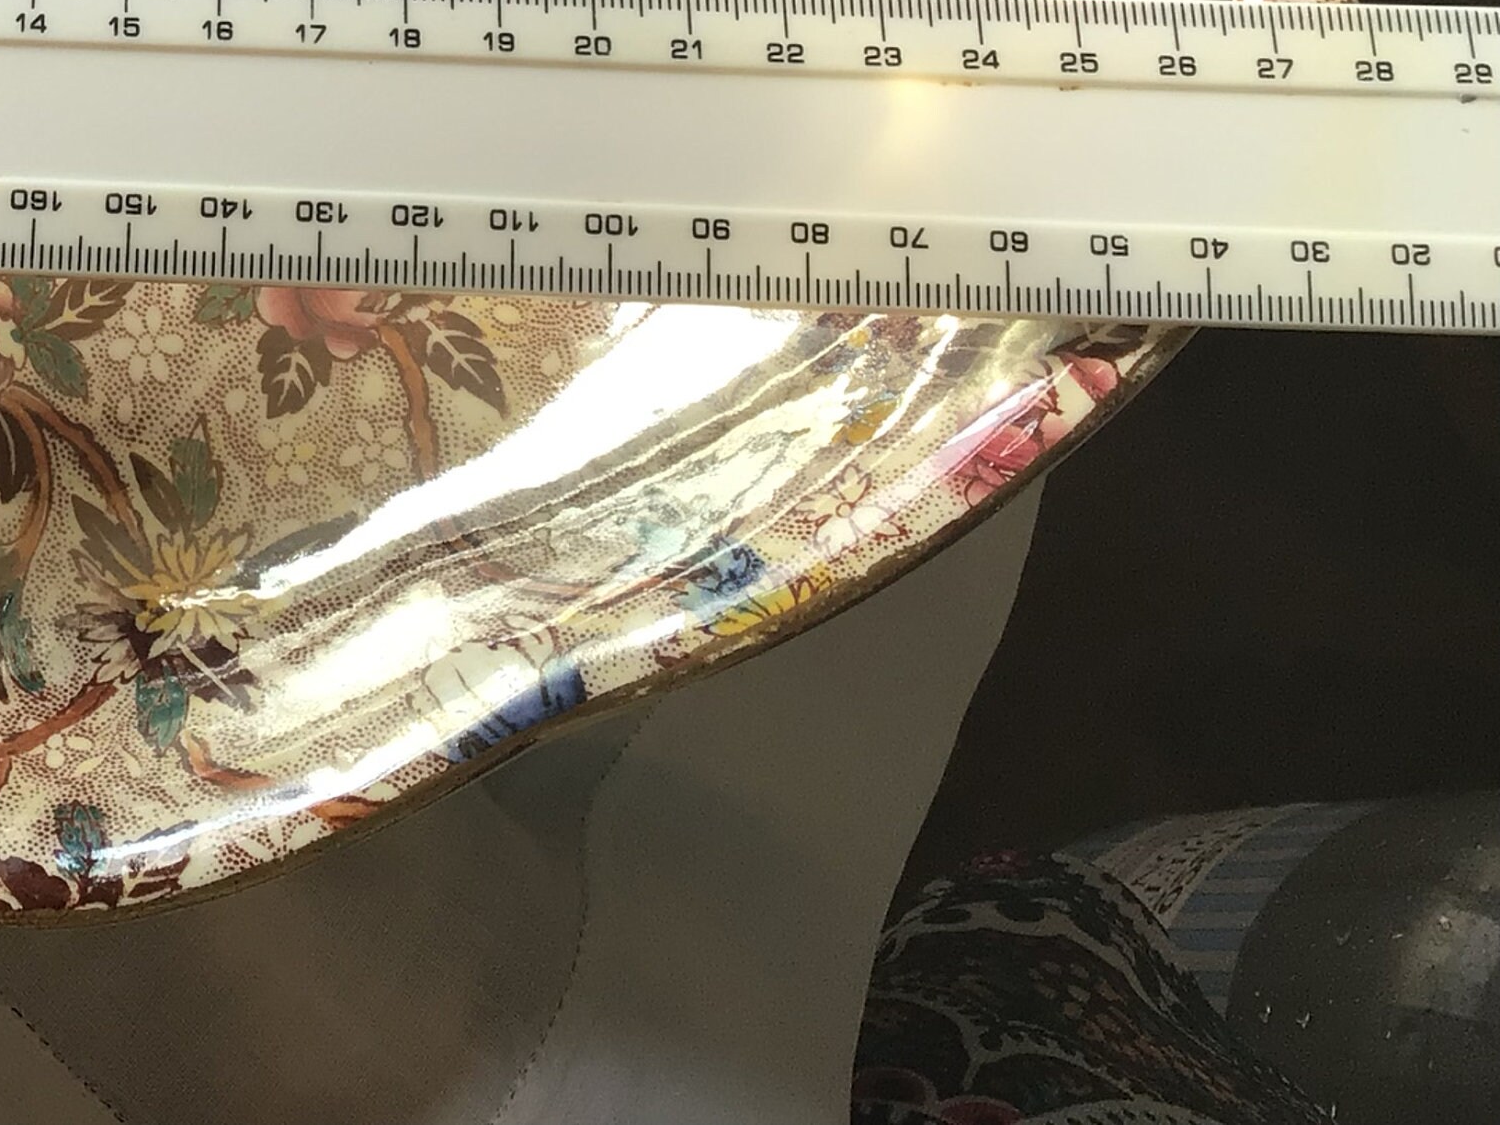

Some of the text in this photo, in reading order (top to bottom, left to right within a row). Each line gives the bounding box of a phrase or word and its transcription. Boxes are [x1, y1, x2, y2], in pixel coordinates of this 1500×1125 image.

[16, 13, 46, 33] 14
[109, 17, 140, 37] 15
[203, 21, 233, 40] 16
[296, 24, 326, 43] 17
[390, 28, 420, 48] 18
[484, 32, 514, 52] 19
[575, 36, 611, 55] 20
[671, 39, 701, 59] 21
[767, 43, 804, 63] 22
[864, 46, 902, 66] 23
[963, 50, 999, 69] 24
[1060, 53, 1098, 73] 25
[1159, 56, 1196, 76] 26
[1257, 58, 1293, 78] 27
[1356, 61, 1393, 81] 28
[1455, 64, 1492, 83] 29
[11, 190, 62, 211] 160
[106, 193, 157, 215] 150
[201, 197, 252, 219] 140
[296, 201, 348, 223] 130
[392, 205, 443, 227] 120
[490, 209, 538, 232] 110
[585, 214, 638, 236] 100
[693, 218, 729, 240] 90
[791, 222, 829, 244] 80
[890, 227, 928, 249] 70
[990, 231, 1028, 252] 60
[1091, 235, 1128, 256] 50
[1191, 238, 1228, 259] 40
[1291, 241, 1329, 262] 30
[1392, 244, 1430, 265] 20
